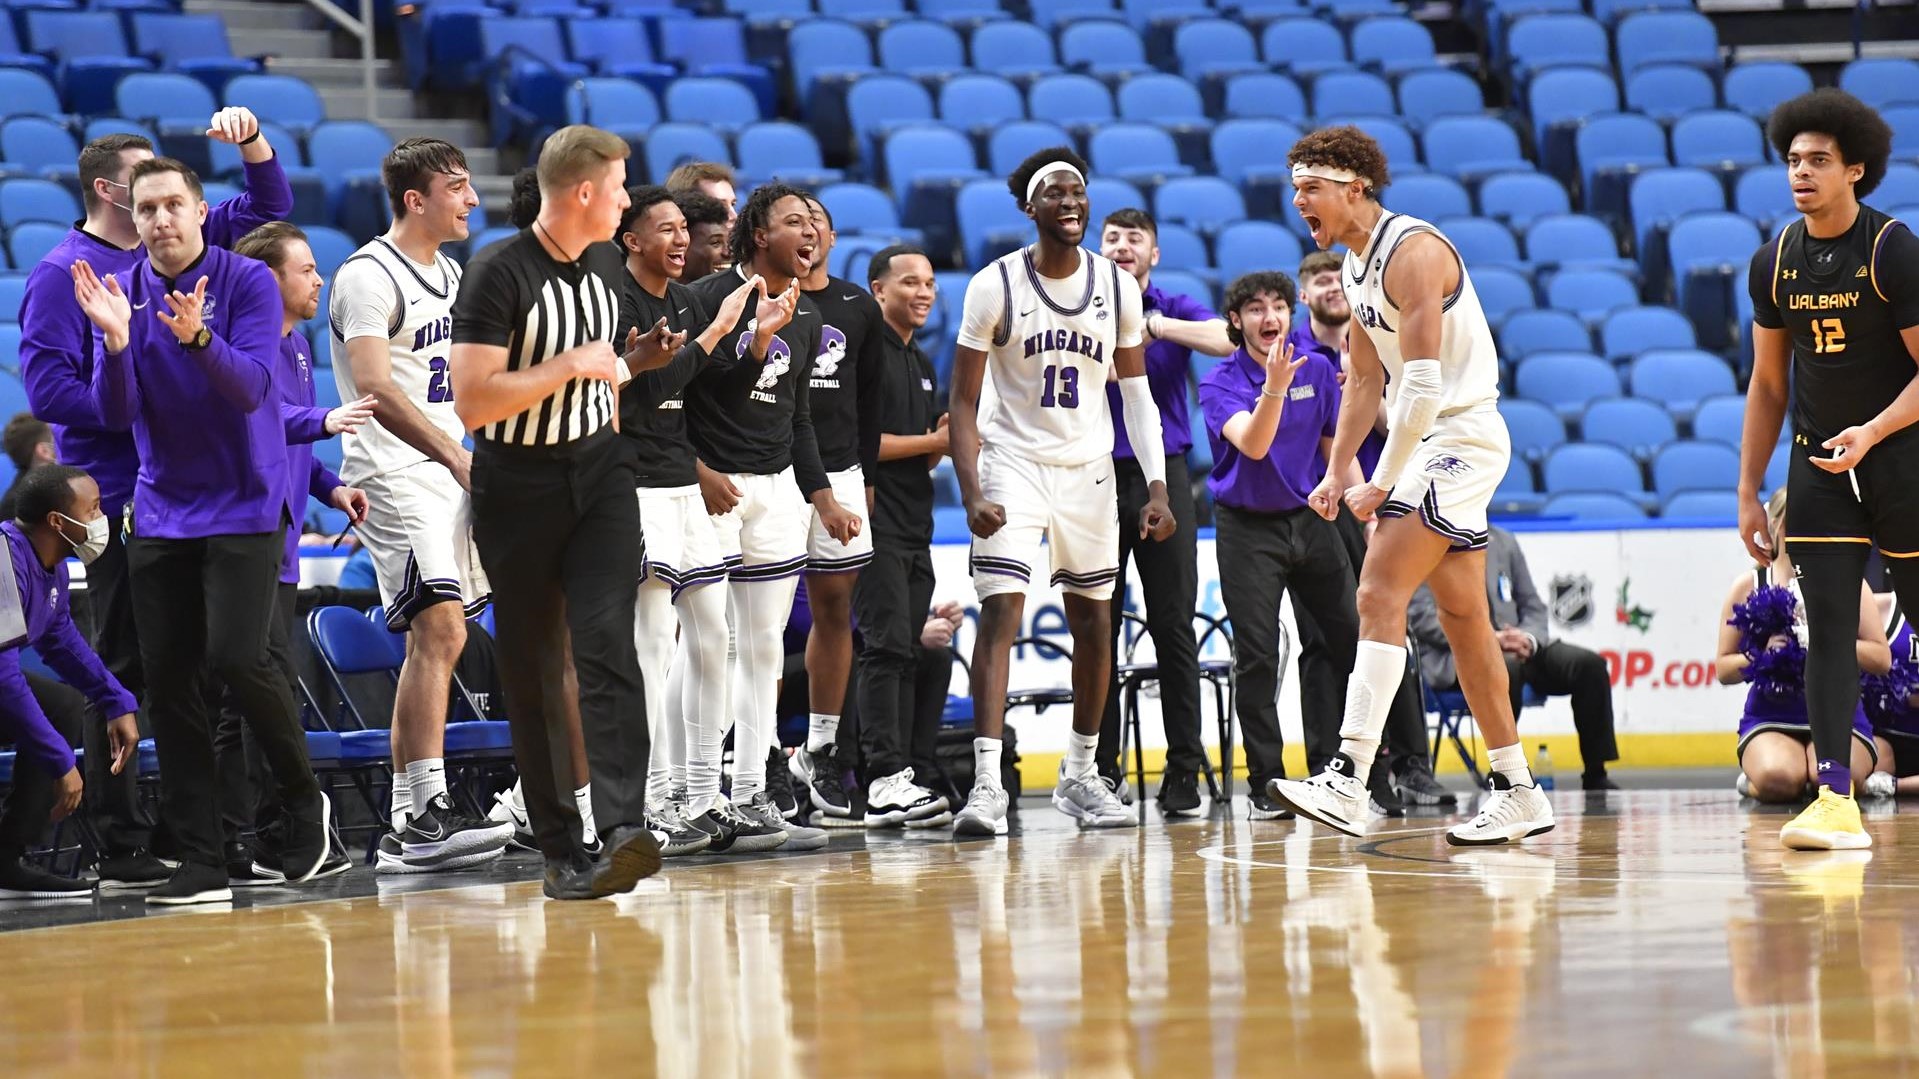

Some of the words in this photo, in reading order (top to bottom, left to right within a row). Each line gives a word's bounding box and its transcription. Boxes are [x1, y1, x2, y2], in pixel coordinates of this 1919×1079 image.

[1789, 291, 1860, 310] UALBANY
[1024, 329, 1103, 364] NIAGARA
[1811, 318, 1846, 353] 12
[1040, 364, 1080, 409] 13
